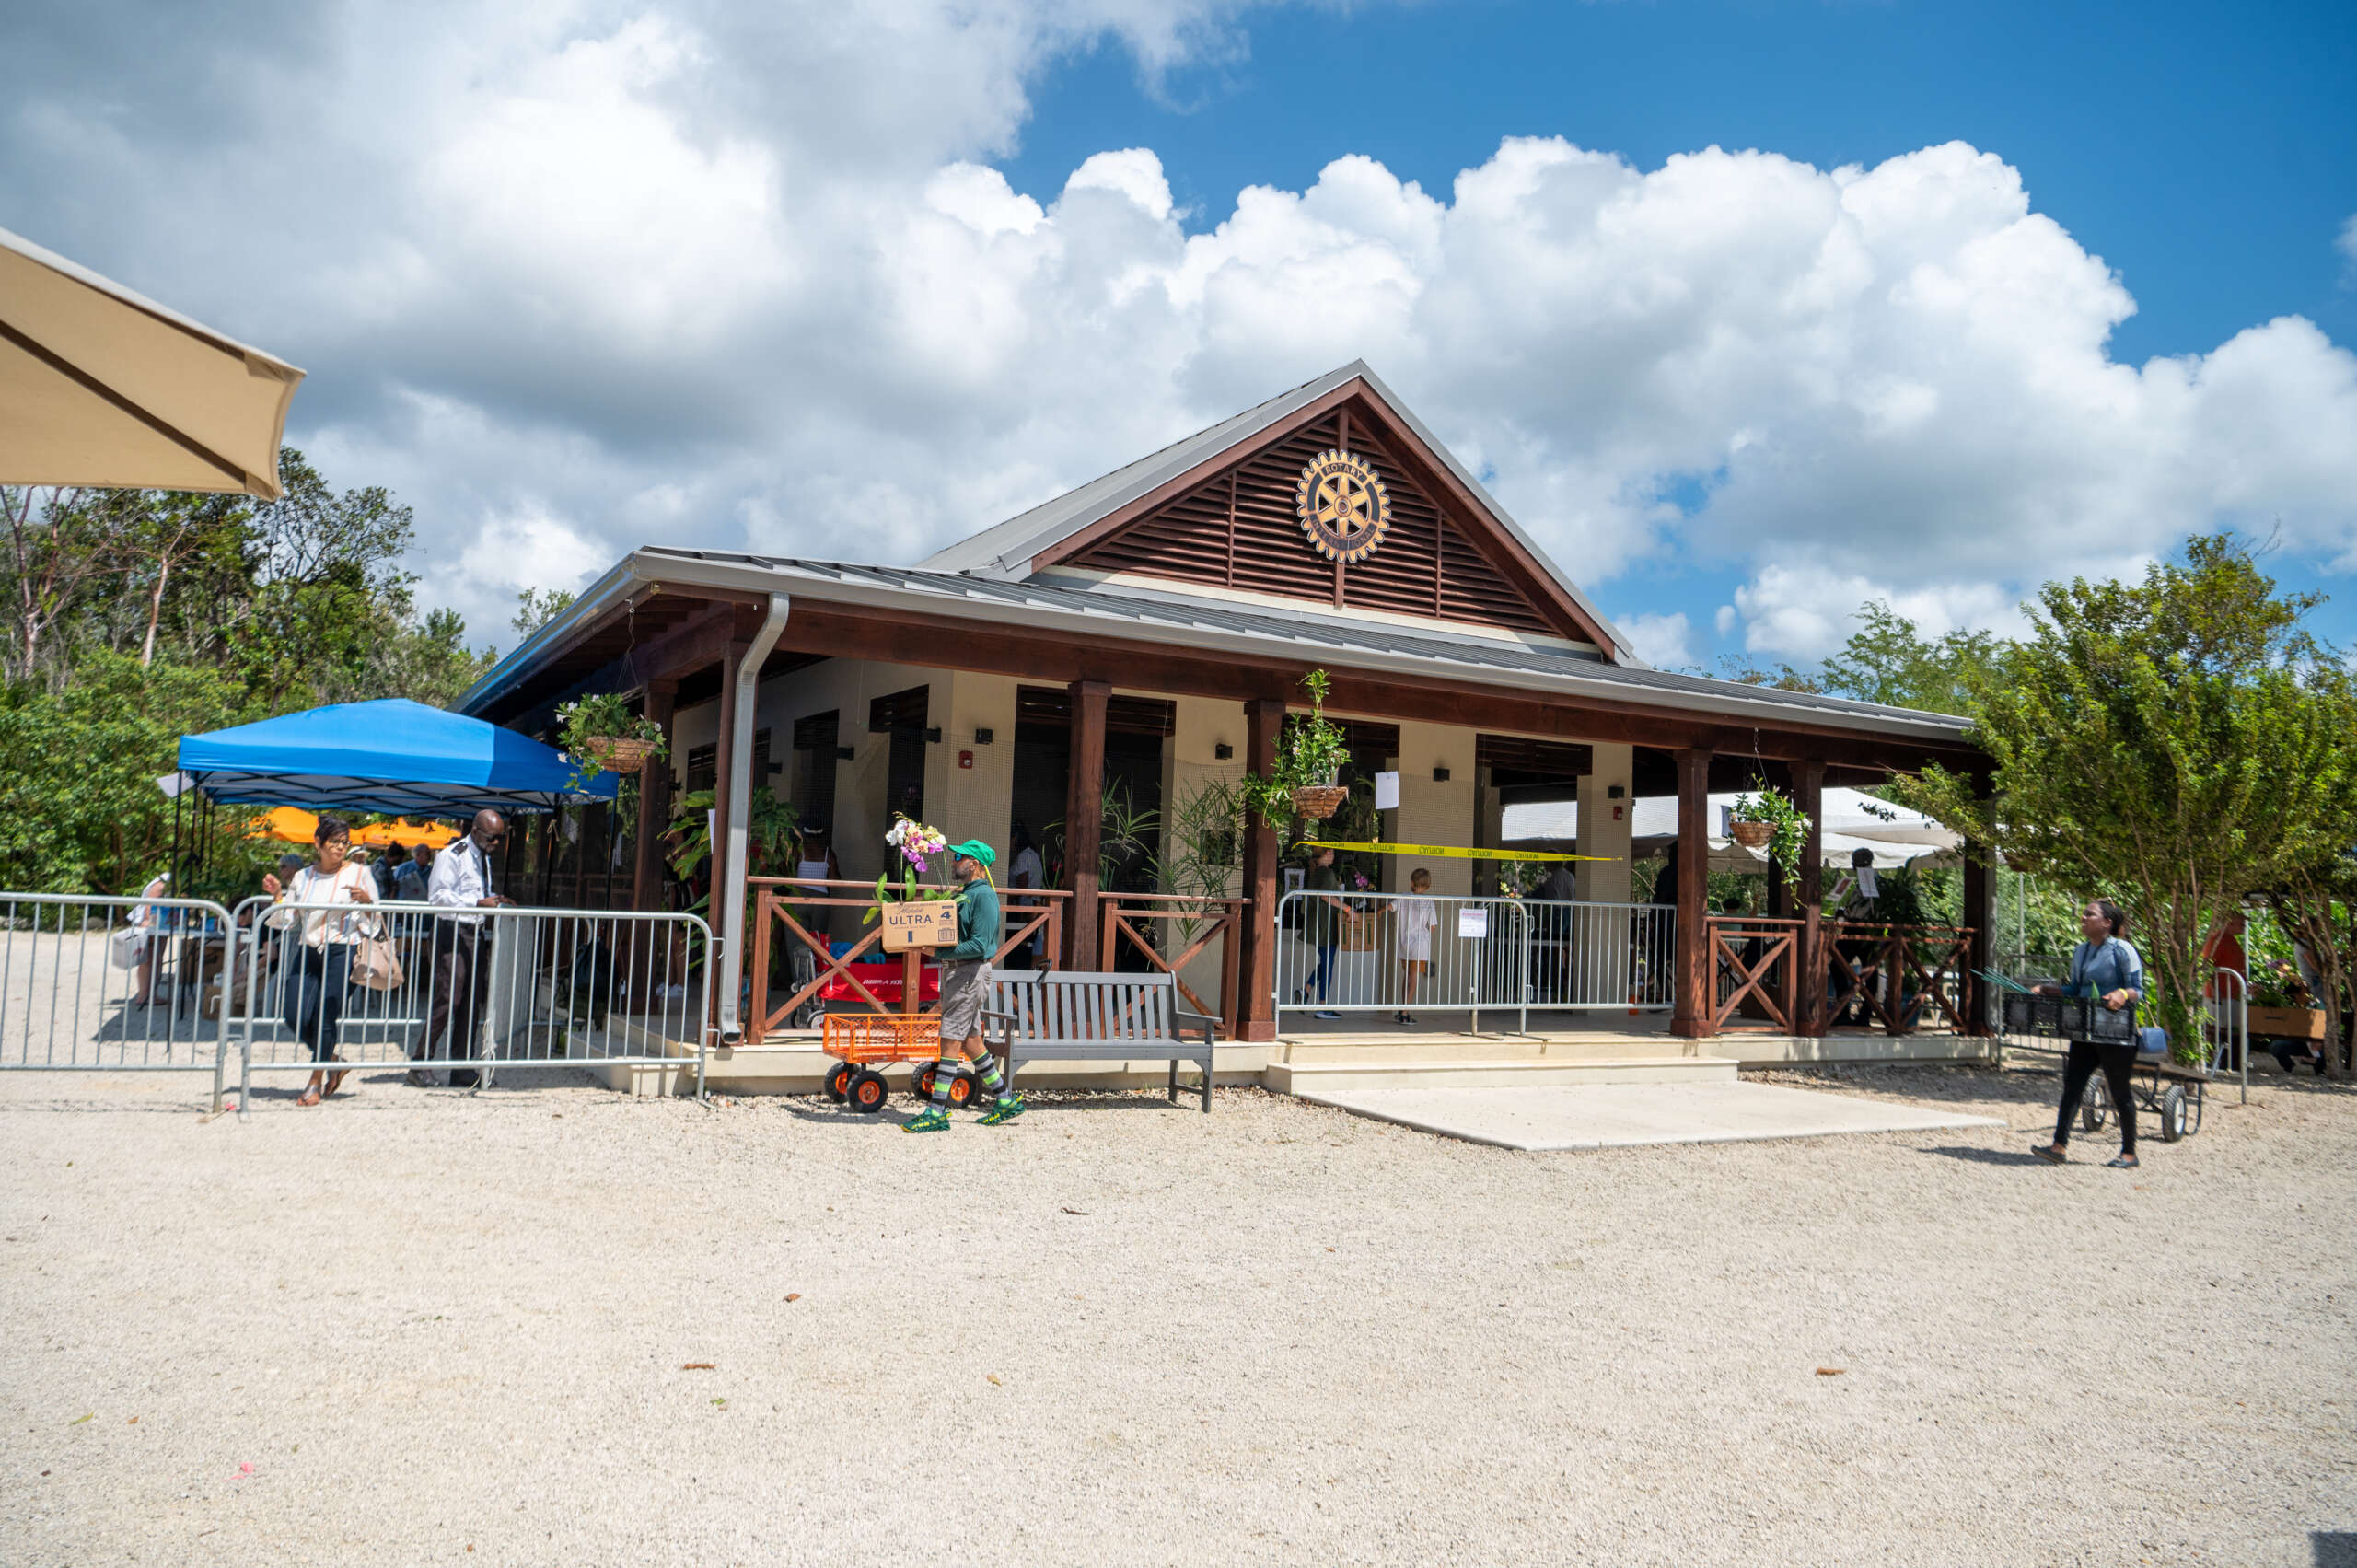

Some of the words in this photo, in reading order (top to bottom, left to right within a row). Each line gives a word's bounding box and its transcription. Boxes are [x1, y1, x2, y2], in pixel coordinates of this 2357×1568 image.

[1325, 463, 1363, 479] ROTARY
[1311, 518, 1376, 550] INTERNIONAL
[889, 914, 932, 925] ULTRA
[940, 911, 951, 919] 4
